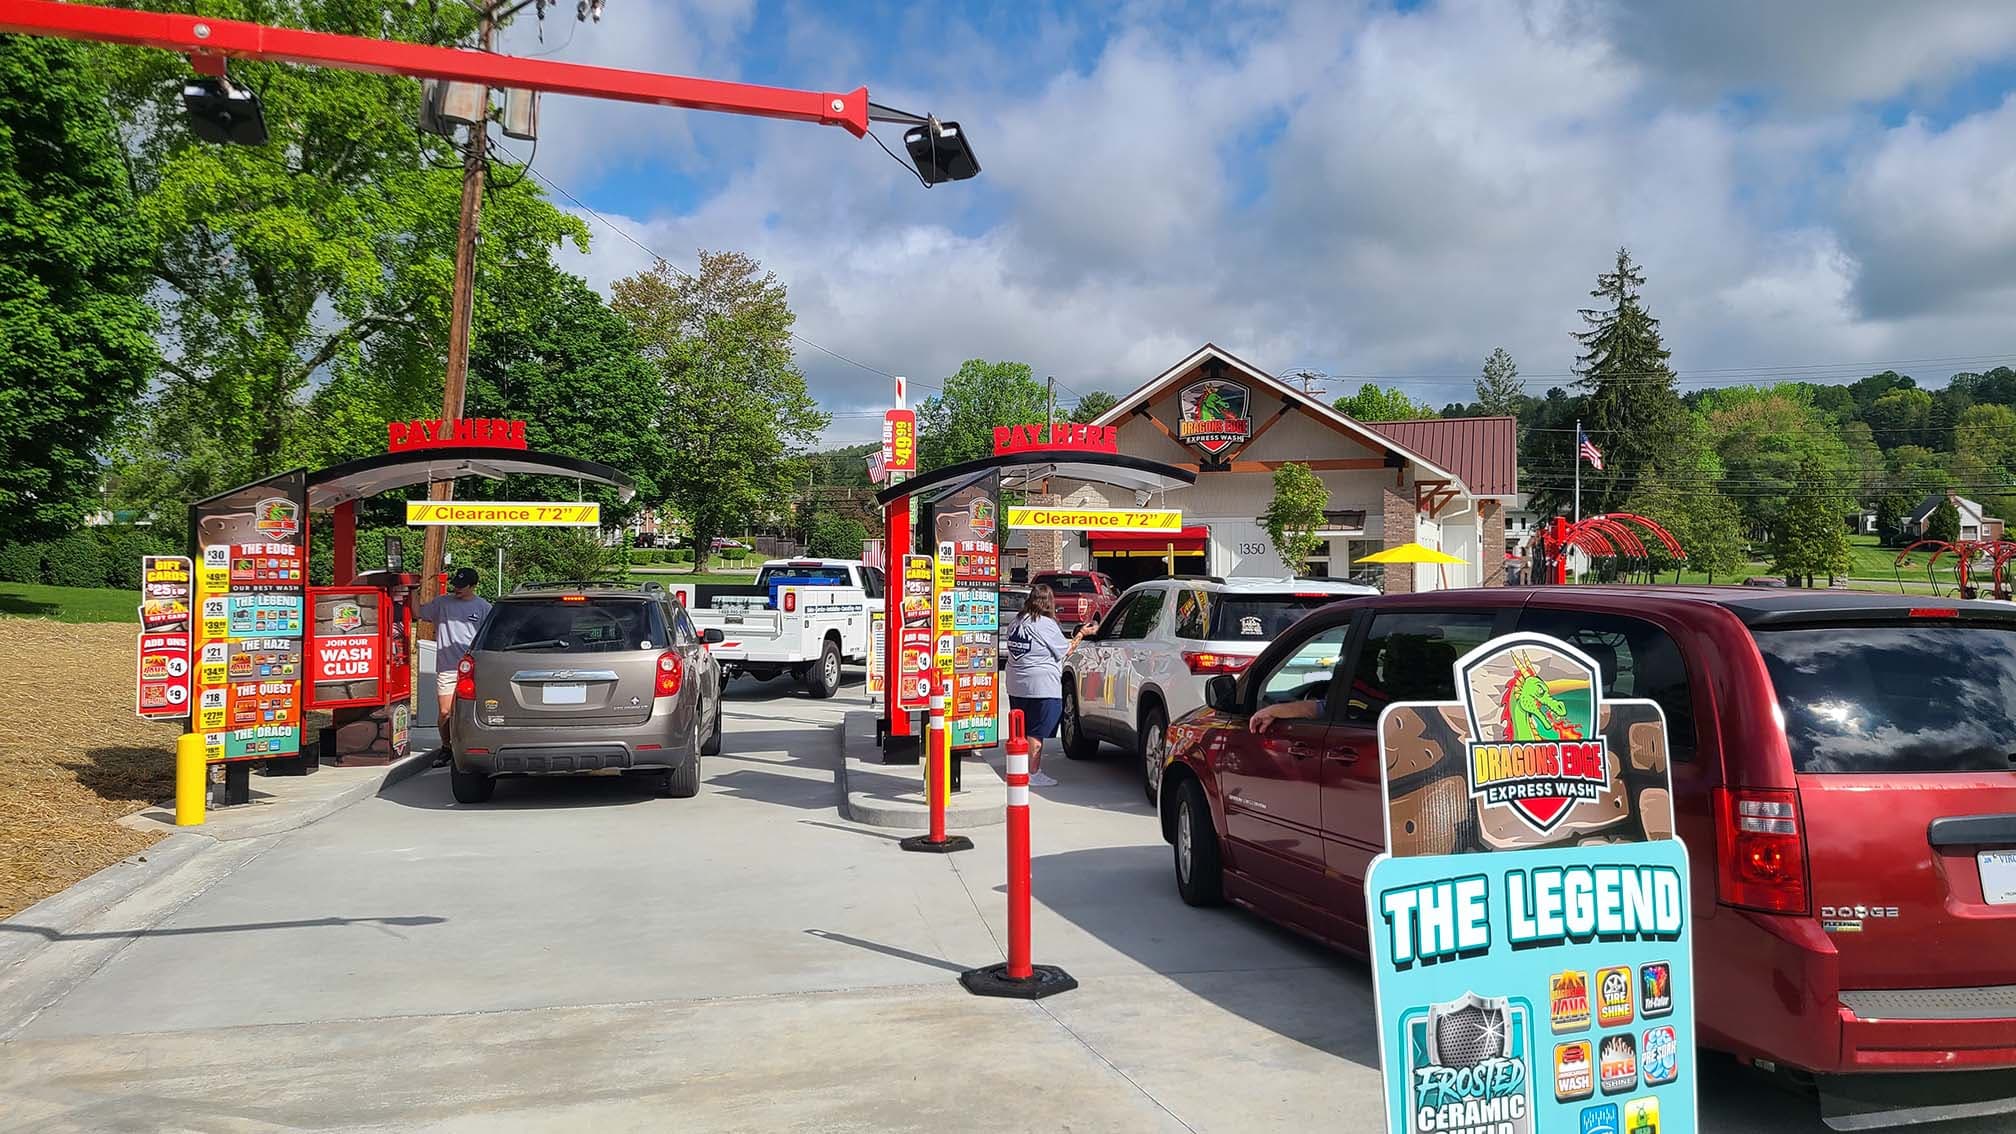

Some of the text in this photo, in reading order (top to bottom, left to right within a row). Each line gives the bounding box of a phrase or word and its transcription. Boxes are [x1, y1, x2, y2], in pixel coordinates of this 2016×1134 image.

[389, 418, 527, 448] PAY HERE
[1181, 420, 1224, 436] DRAGONS
[993, 423, 1117, 450] PAY HERE
[435, 506, 530, 520] Clearance
[1033, 512, 1118, 527] Clearance
[241, 543, 296, 556] THE EDGE
[961, 541, 994, 553] THE EDGE
[1239, 543, 1265, 555] 1350
[207, 550, 225, 560] $30
[147, 560, 188, 582] GIFT CARDS
[235, 596, 297, 608] THE LEGEND
[958, 591, 995, 602] THE LEGEND
[206, 602, 223, 612] $25
[144, 638, 166, 648] ADD
[240, 639, 291, 651] THE HAZE
[962, 633, 991, 644] THE HAZE
[207, 648, 221, 657] $21
[320, 648, 372, 662] WASH
[170, 662, 182, 673] $4
[323, 661, 369, 675] CLUB
[959, 677, 971, 687] THE
[972, 676, 992, 687] QUEST
[170, 690, 181, 700] $9
[237, 684, 292, 697] THE QUEST
[958, 719, 969, 729] THE
[234, 726, 292, 741] THE DRACO
[1475, 742, 1605, 783] DRAGONS EDGE
[1488, 782, 1596, 802] EXPRESS WASH
[1381, 865, 1683, 968] THE LEGEND
[1821, 905, 1899, 918] DODGE
[1604, 991, 1626, 1006] TIRE
[1601, 1004, 1630, 1019] SHINE
[1602, 1059, 1635, 1079] FIRE
[1415, 1056, 1526, 1112] FROSTED
[1558, 1074, 1590, 1092] WASH
[1606, 1078, 1633, 1088] SHINE
[1418, 1094, 1525, 1132] CERAMIC
